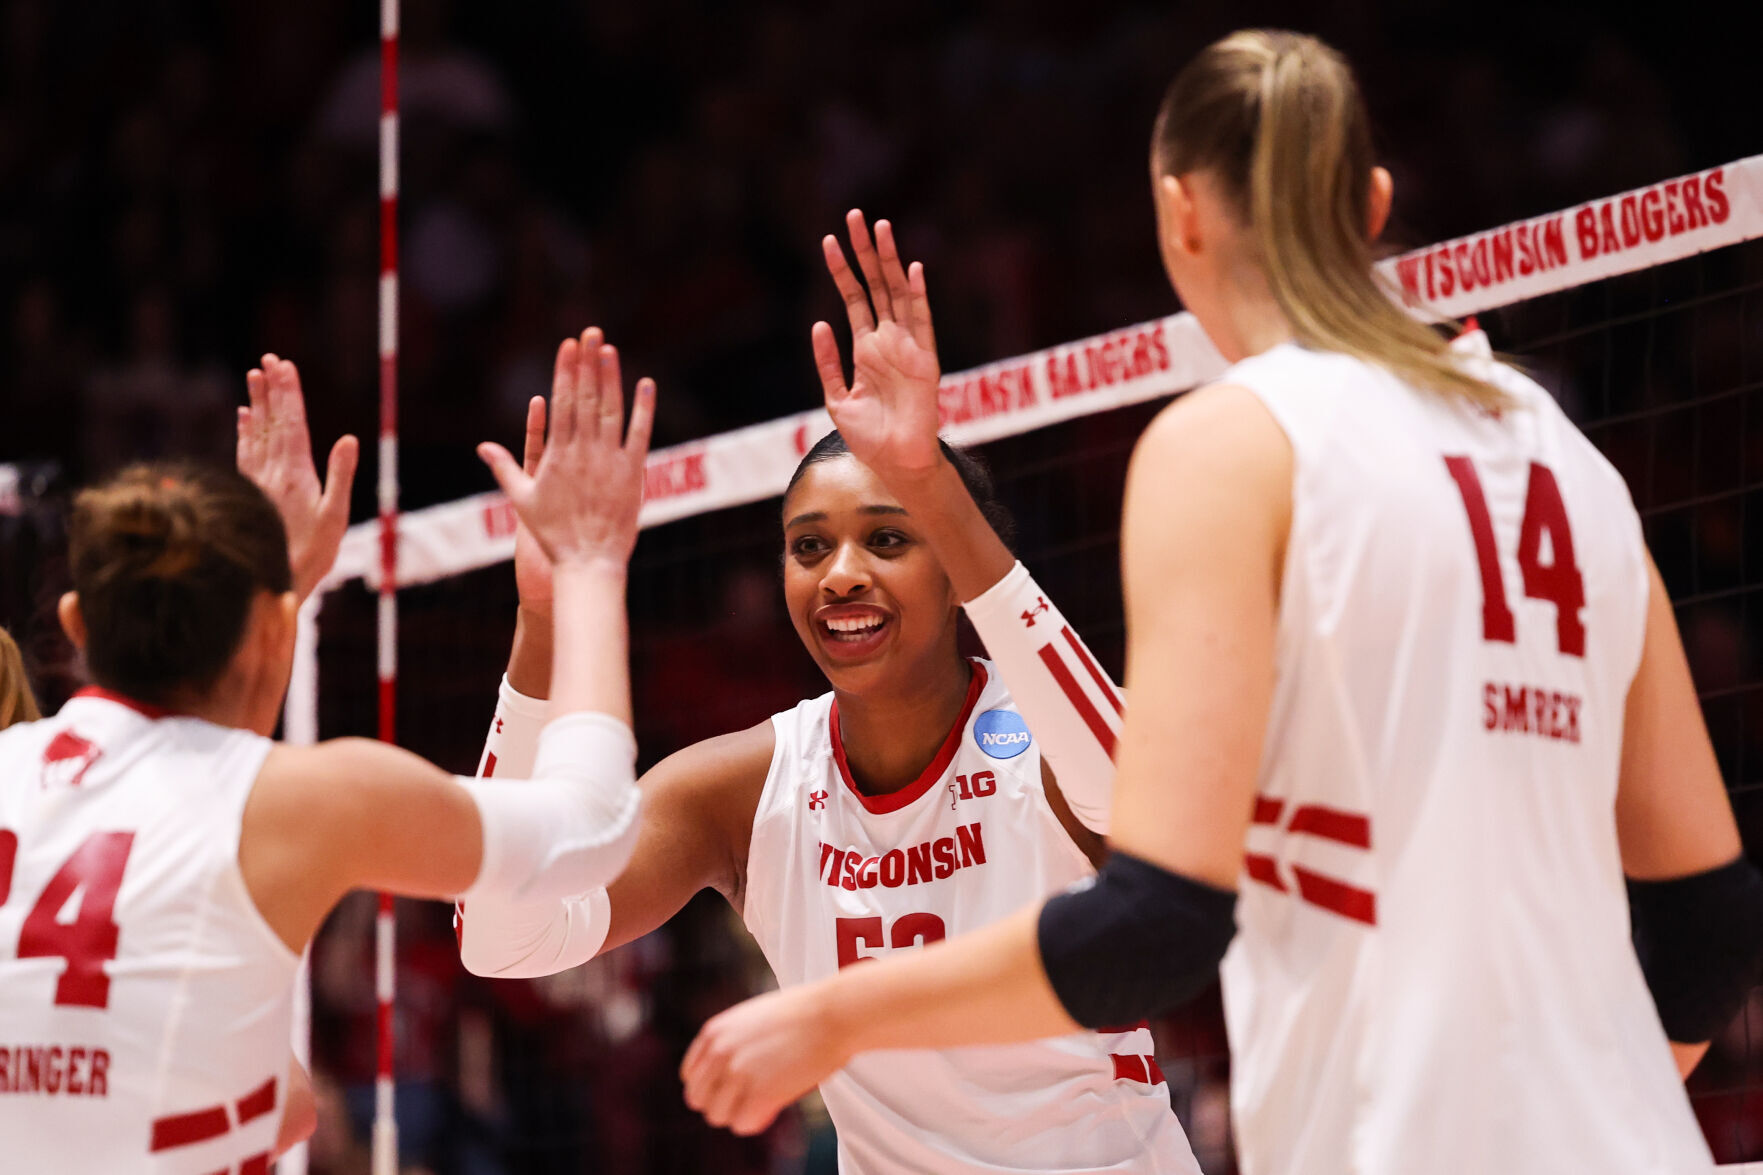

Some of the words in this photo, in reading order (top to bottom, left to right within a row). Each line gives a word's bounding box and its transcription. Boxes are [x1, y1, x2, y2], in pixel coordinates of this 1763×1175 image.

[1576, 167, 1730, 261] BADGERS
[1442, 455, 1586, 658] 14
[982, 731, 1029, 746] NCAA
[949, 770, 997, 811] 1G
[0, 828, 137, 1009] 4
